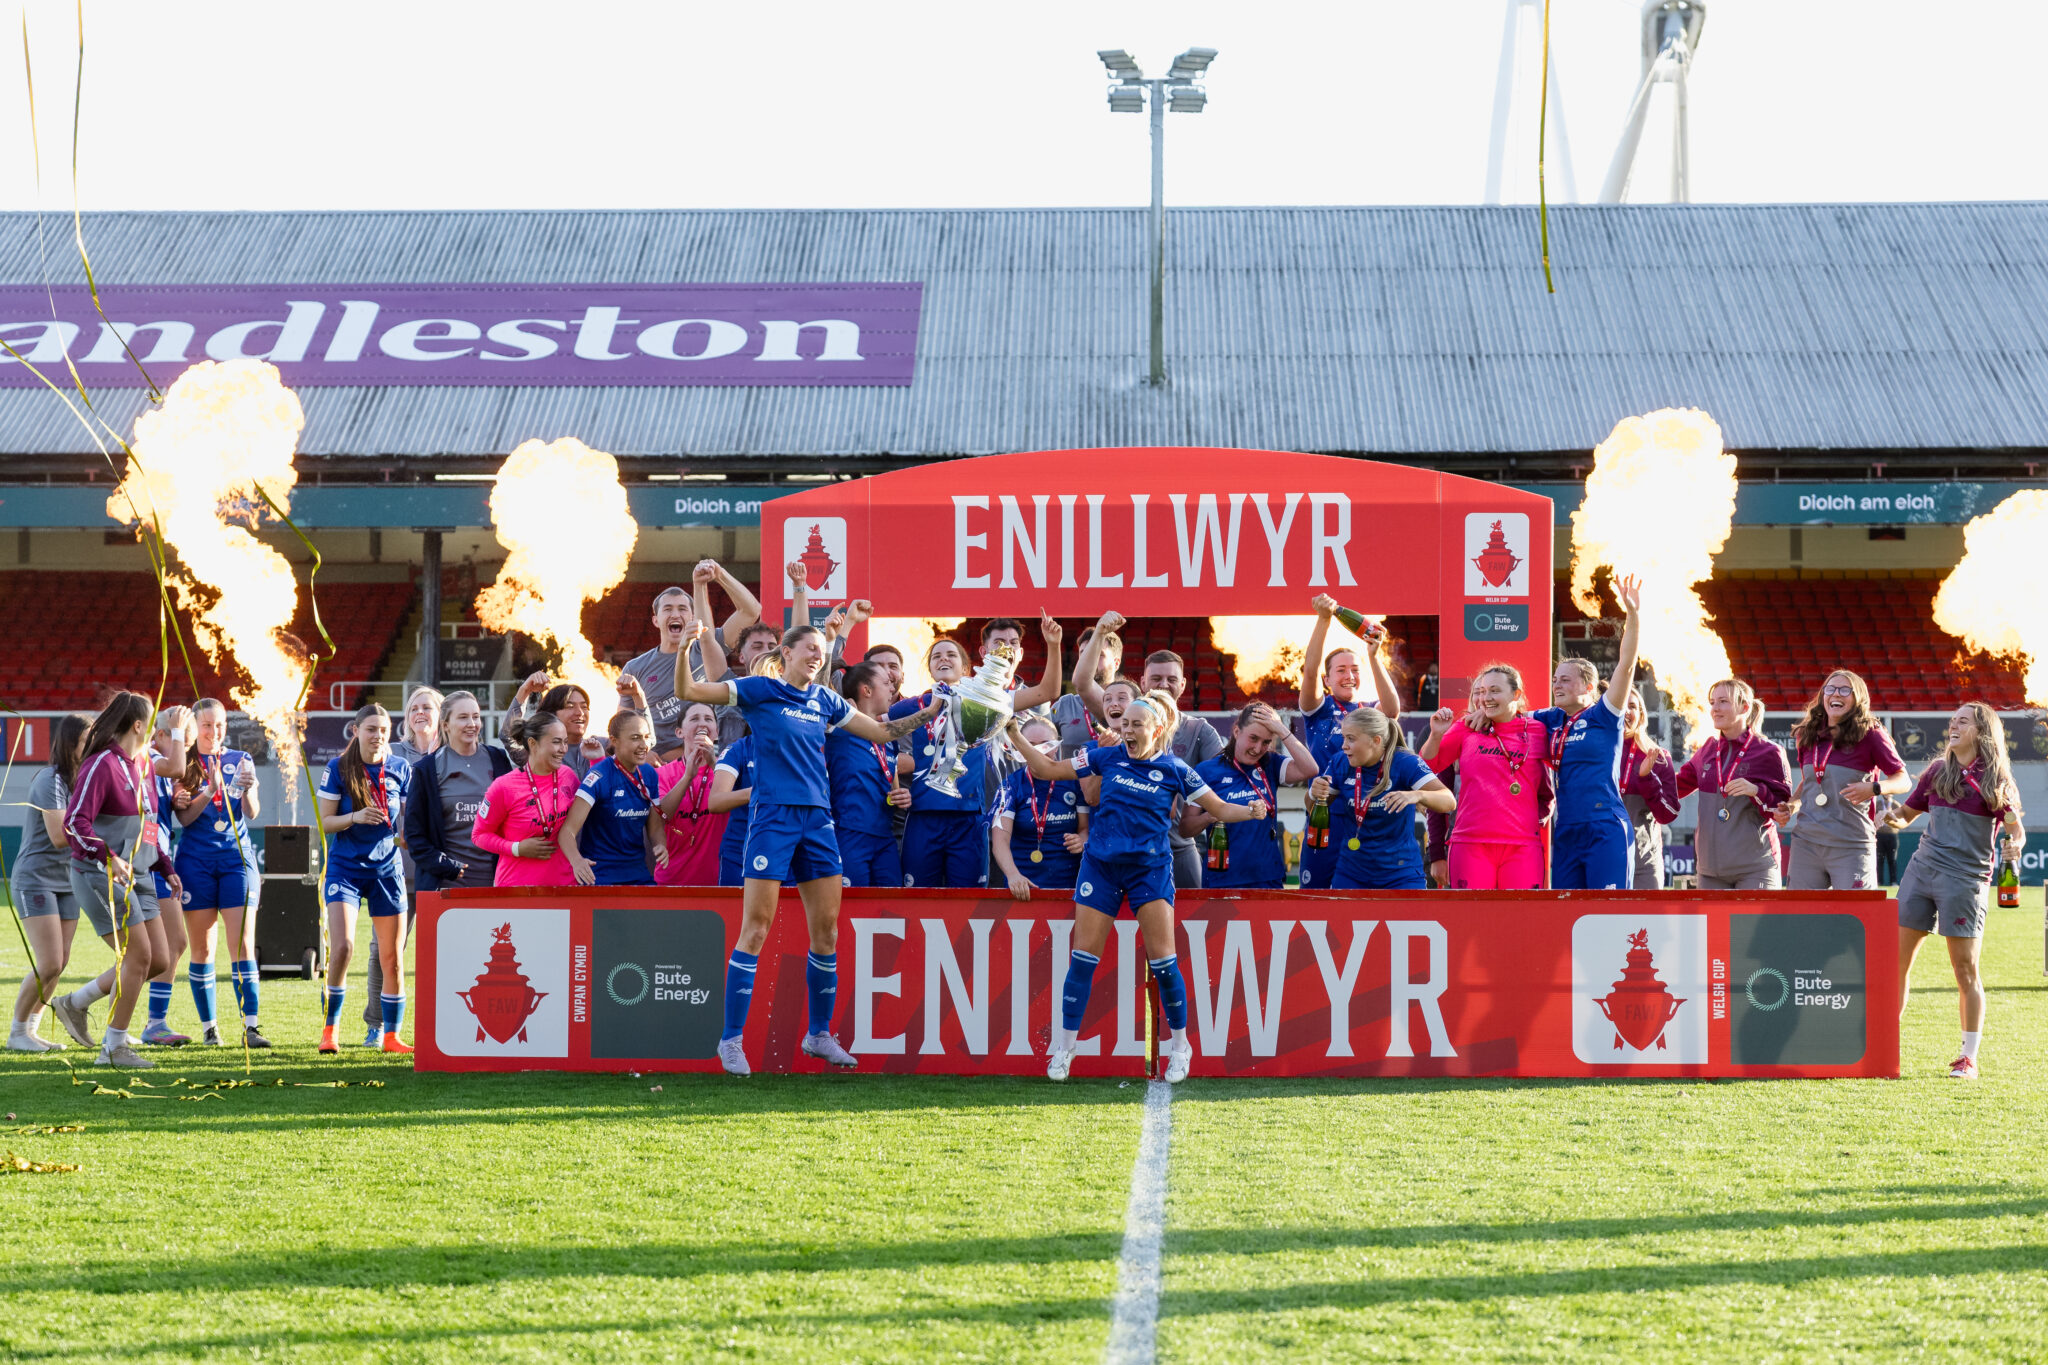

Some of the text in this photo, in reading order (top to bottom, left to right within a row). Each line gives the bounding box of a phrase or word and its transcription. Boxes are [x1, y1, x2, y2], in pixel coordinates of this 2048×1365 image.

[0, 301, 865, 363] andleston
[675, 497, 730, 513] Diolch
[1799, 493, 1934, 510] Diolch am eich
[951, 493, 1358, 588] ENILLWYR
[1494, 624, 1520, 632] Energy
[445, 661, 485, 669] RODNEY
[1112, 775, 1159, 793] Nathaniel
[574, 945, 587, 1022] CWPAN CYMRU
[655, 972, 691, 985] Bute
[1794, 977, 1832, 990] Bute
[849, 917, 1458, 1058] ENILLWYR
[1713, 959, 1725, 1019] WELSH CUP
[655, 988, 710, 1004] Energy
[1794, 993, 1851, 1009] Energy
[488, 998, 518, 1014] FAW
[1625, 1004, 1656, 1021] FAW
